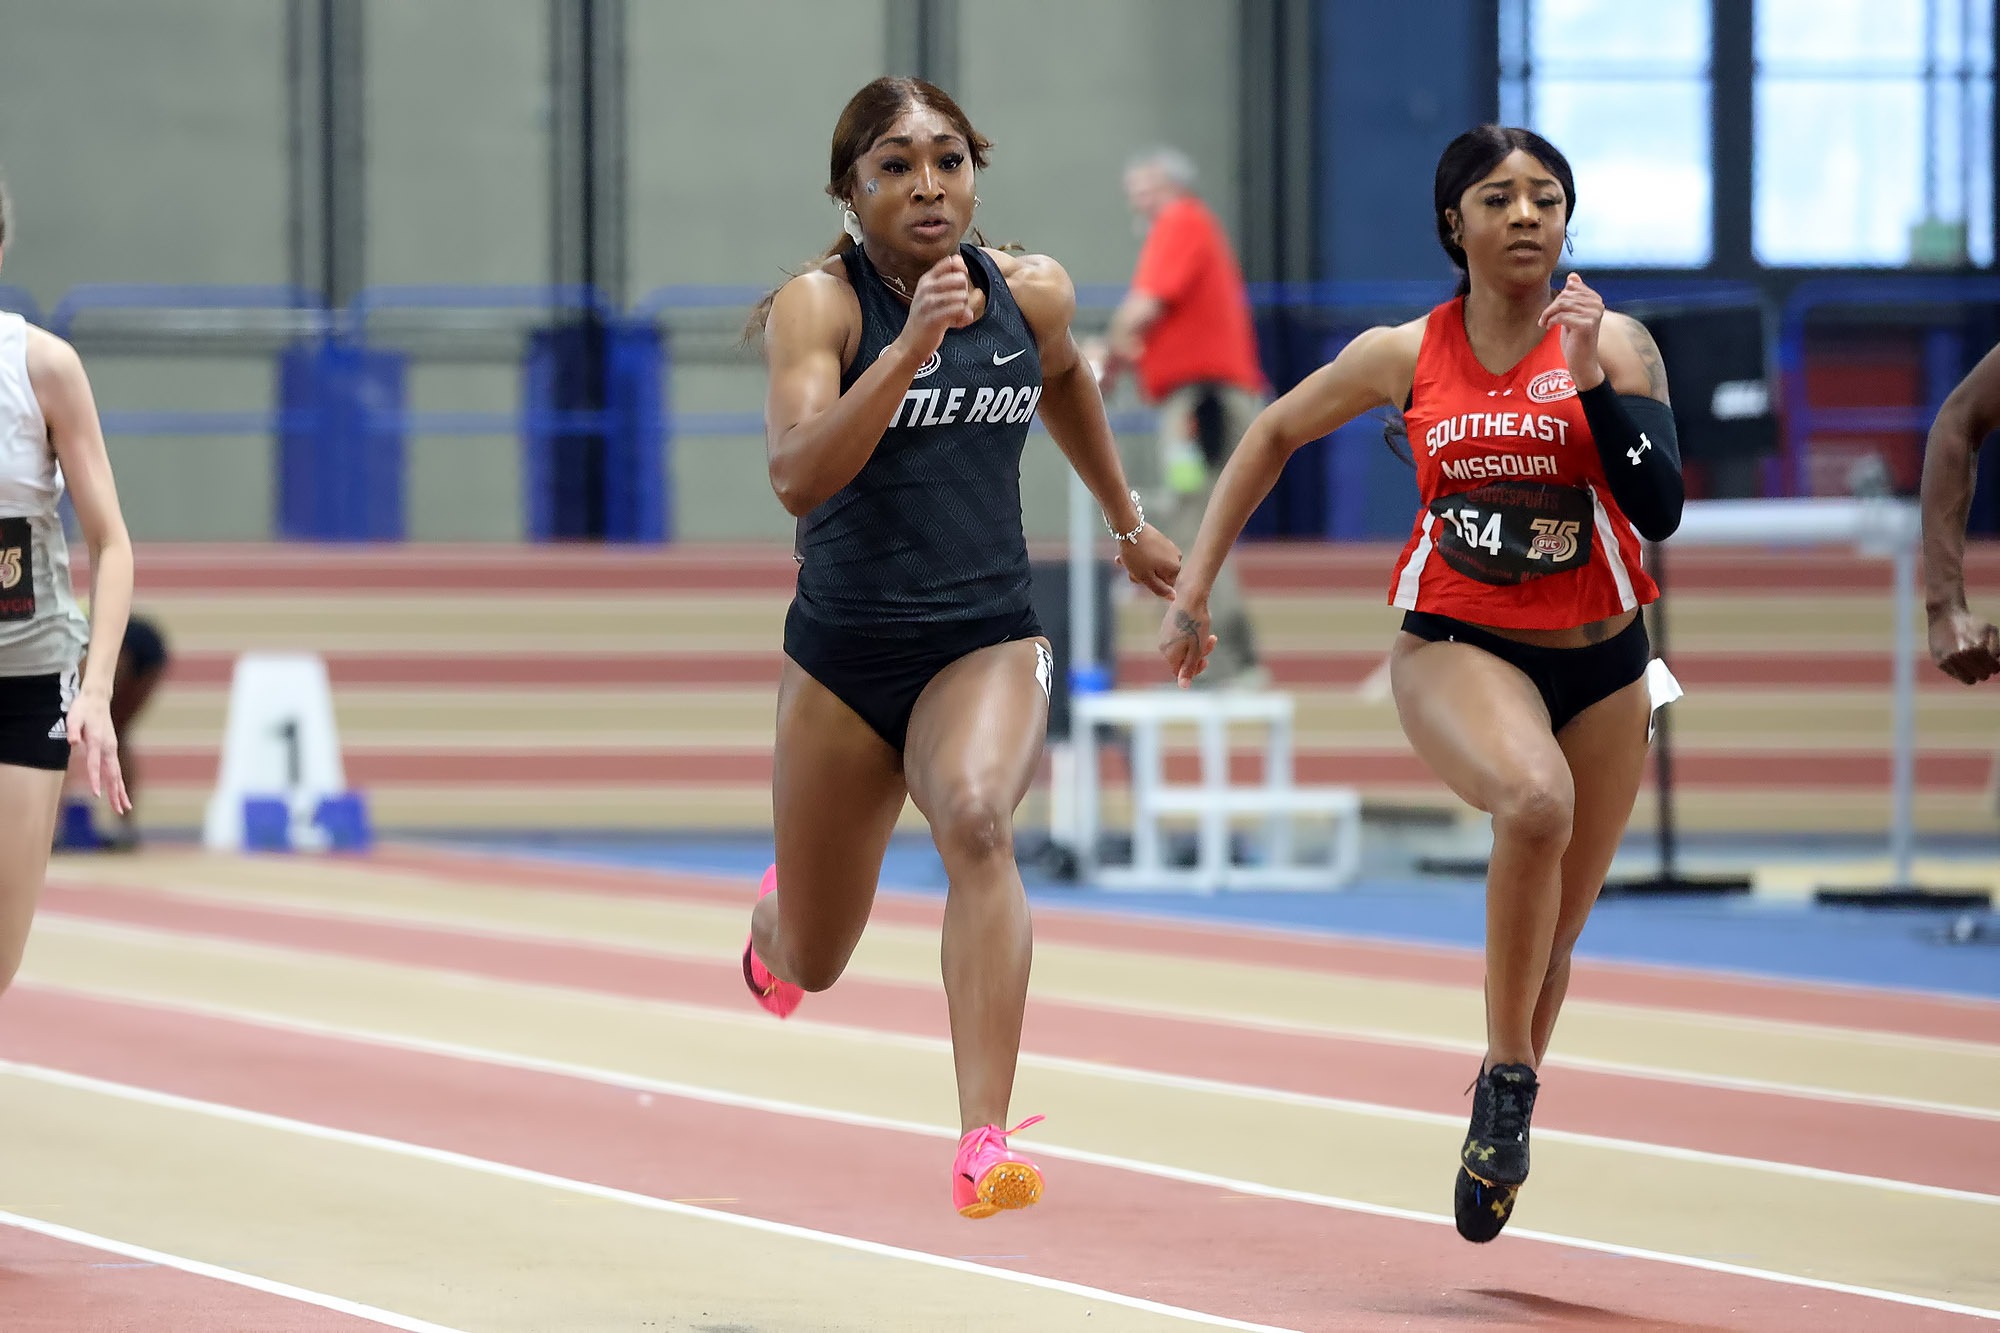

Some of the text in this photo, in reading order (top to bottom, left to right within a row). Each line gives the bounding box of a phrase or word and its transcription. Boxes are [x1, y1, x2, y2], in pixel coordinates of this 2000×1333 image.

[1426, 412, 1569, 457] SOUTHEAST
[1441, 455, 1558, 480] MISSOURI
[1440, 507, 1503, 556] 154
[1526, 518, 1580, 562] 75
[266, 720, 300, 784] 1
